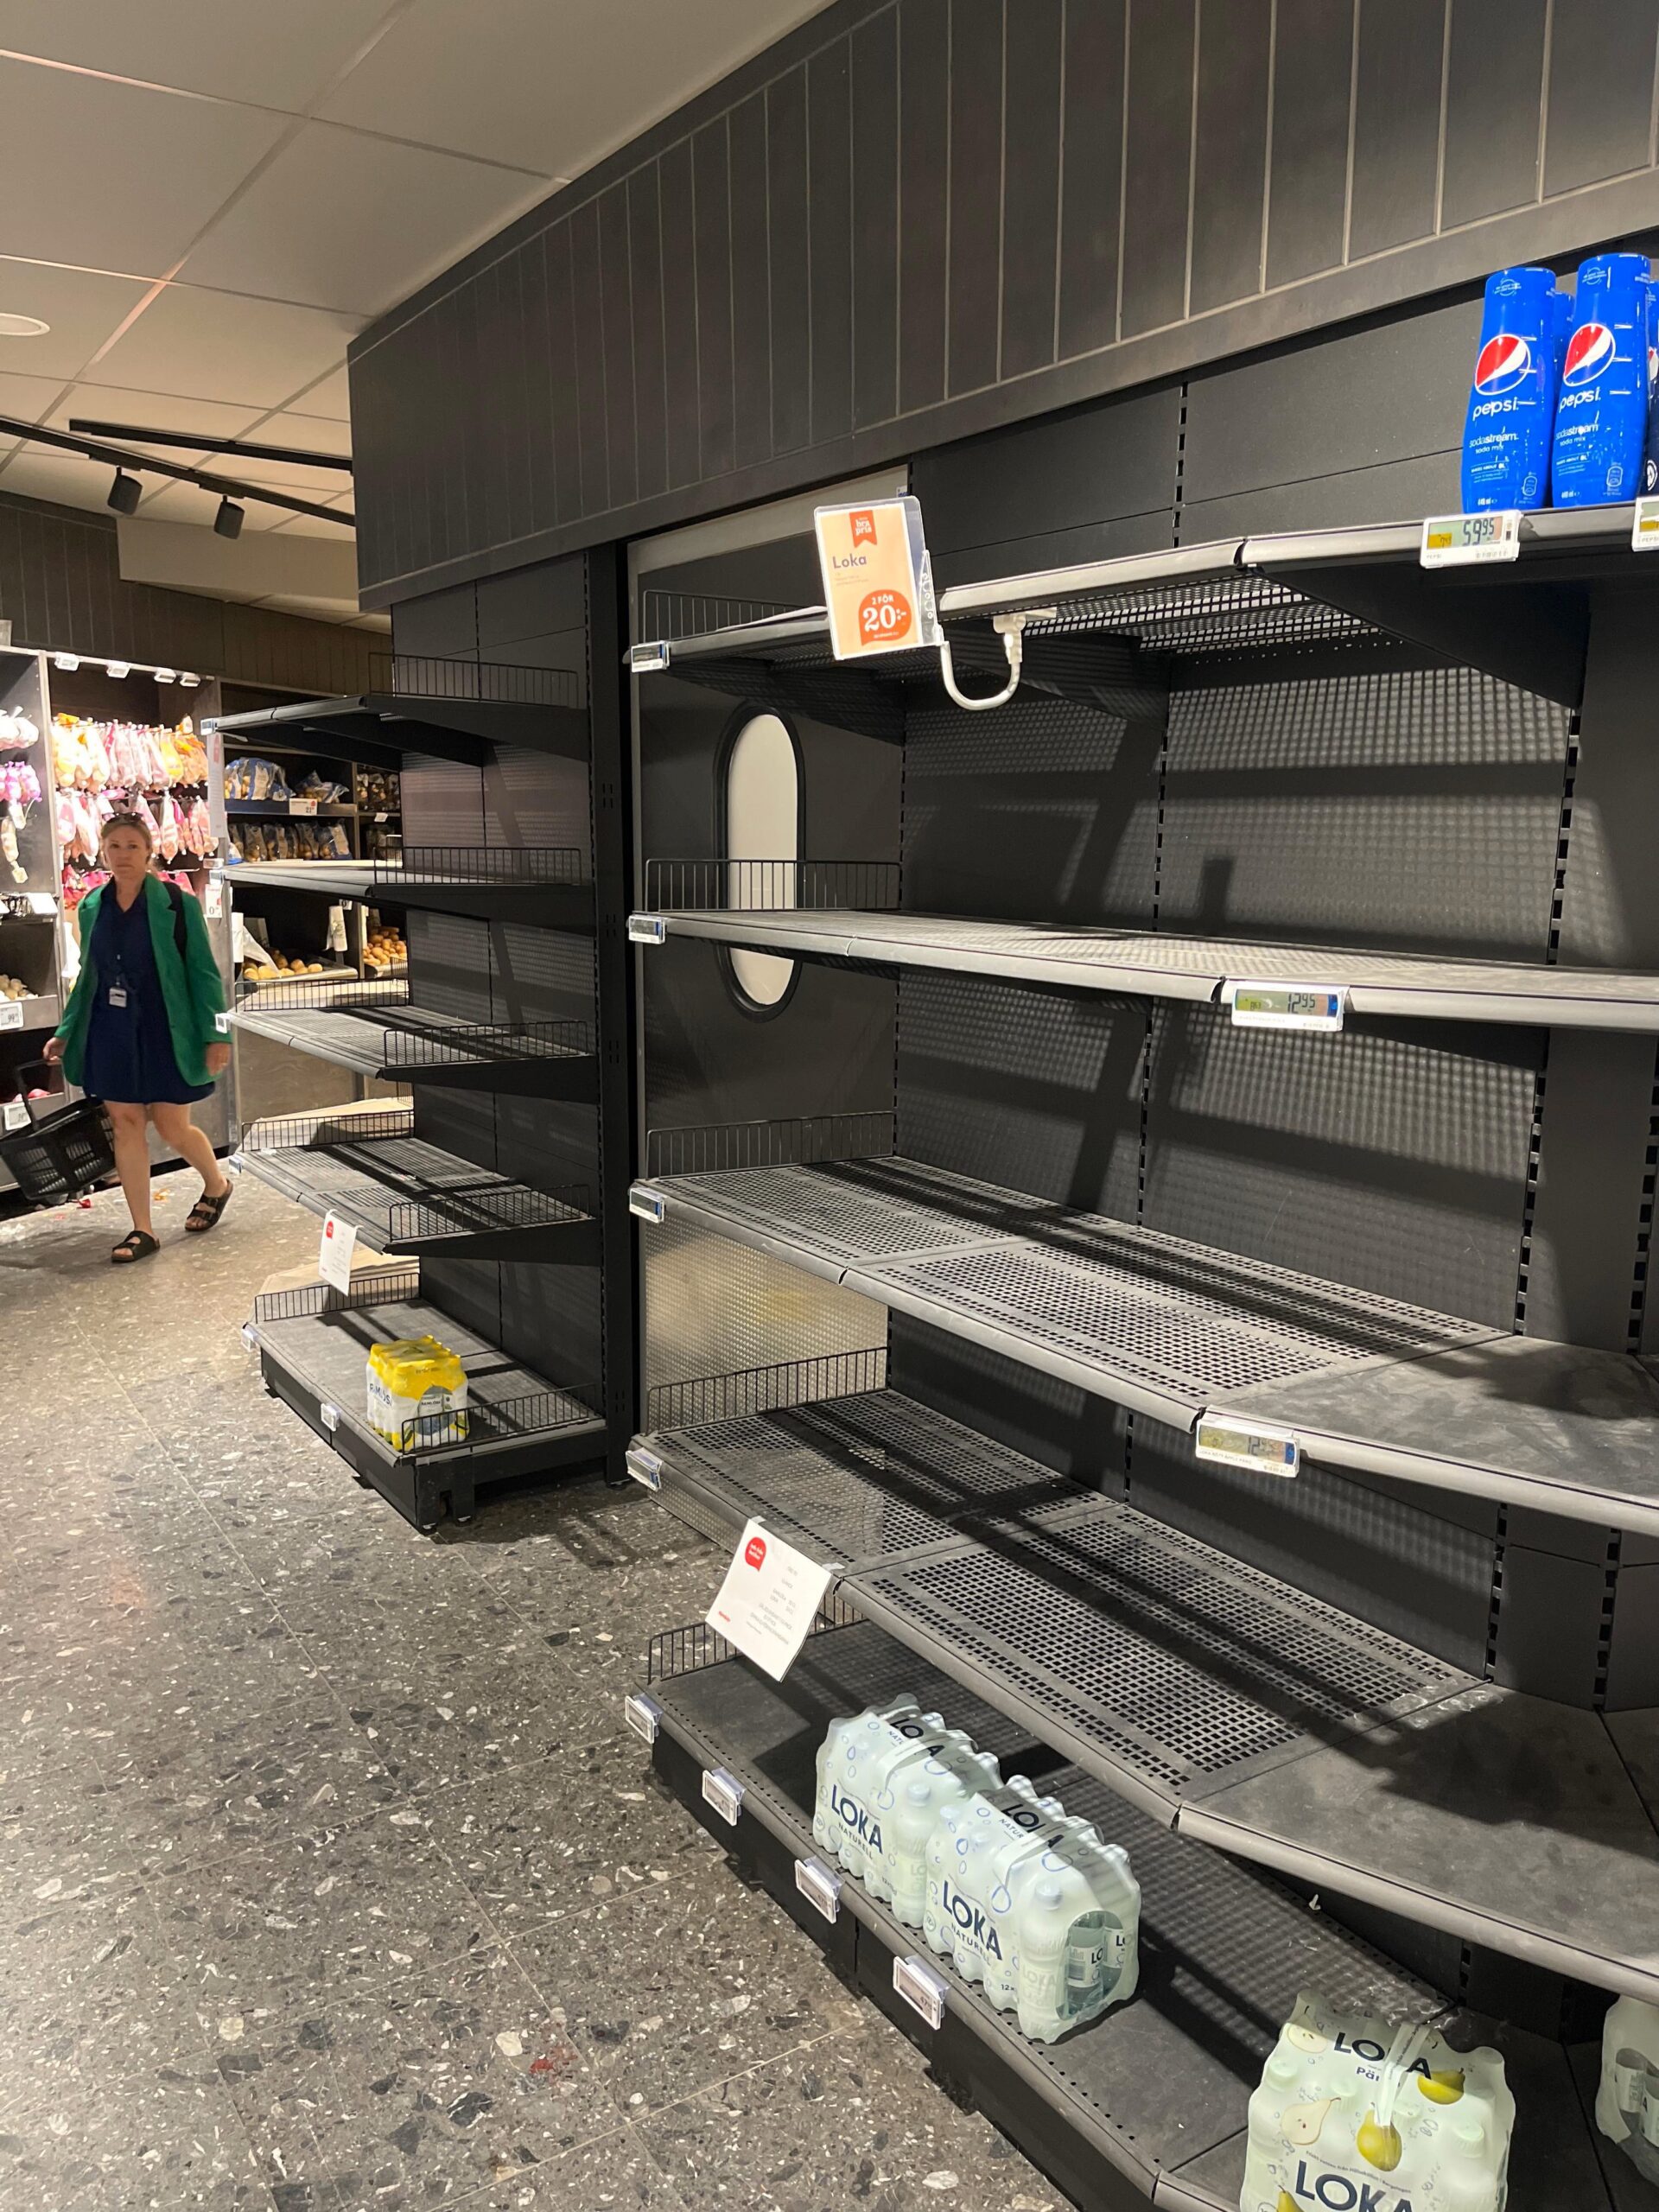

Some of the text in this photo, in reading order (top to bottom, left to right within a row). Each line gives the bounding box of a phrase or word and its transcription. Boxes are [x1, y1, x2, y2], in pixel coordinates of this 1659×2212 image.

[1472, 397, 1518, 422] pepsi
[1559, 386, 1599, 413] pepsi
[1469, 433, 1517, 448] sodastream
[855, 526, 872, 536] pris
[832, 553, 867, 569] Loka
[878, 594, 893, 604] FÖR
[890, 1718, 945, 1758] LOA
[832, 1784, 883, 1854] LOKA
[999, 1819, 1024, 1839] NATUR
[838, 1822, 874, 1860] NATURELL
[944, 1880, 1002, 1961] LOKA
[951, 1923, 991, 1967] NATURELL
[1334, 2031, 1432, 2081] LOA
